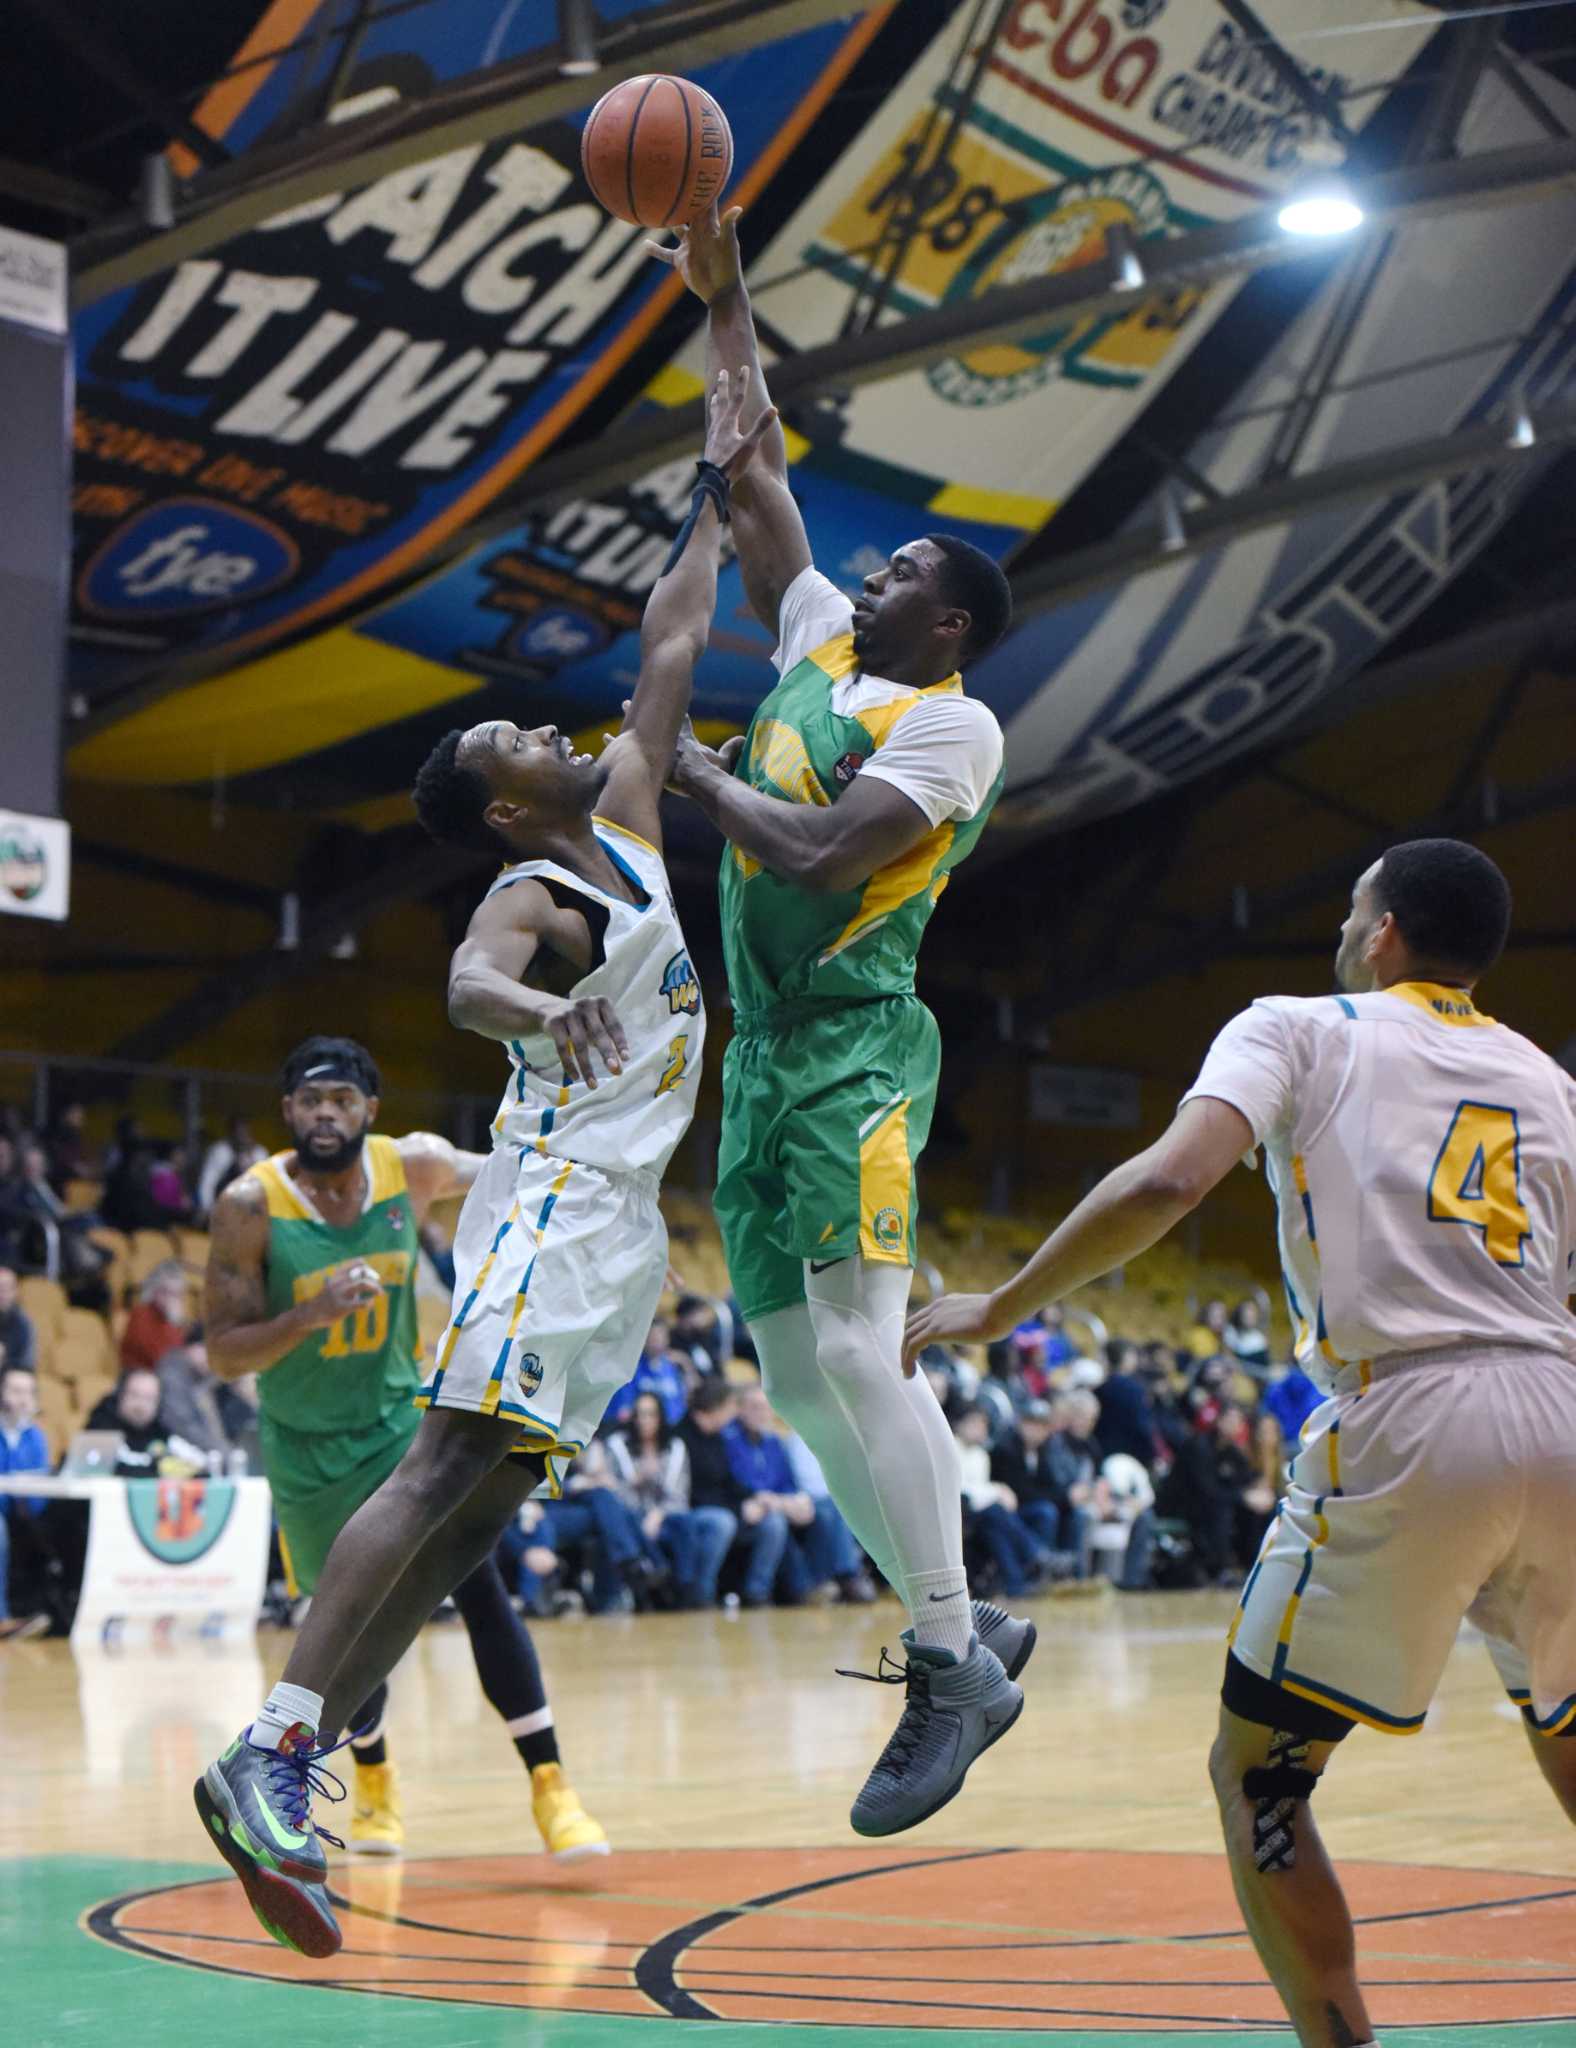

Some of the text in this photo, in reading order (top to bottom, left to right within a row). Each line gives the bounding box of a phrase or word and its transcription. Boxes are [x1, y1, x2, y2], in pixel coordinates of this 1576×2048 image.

[257, 143, 675, 345] ATCH
[119, 260, 551, 470] IT LIVE
[119, 524, 256, 598] fye
[1427, 1099, 1533, 1268] 4
[320, 1288, 391, 1360] 10
